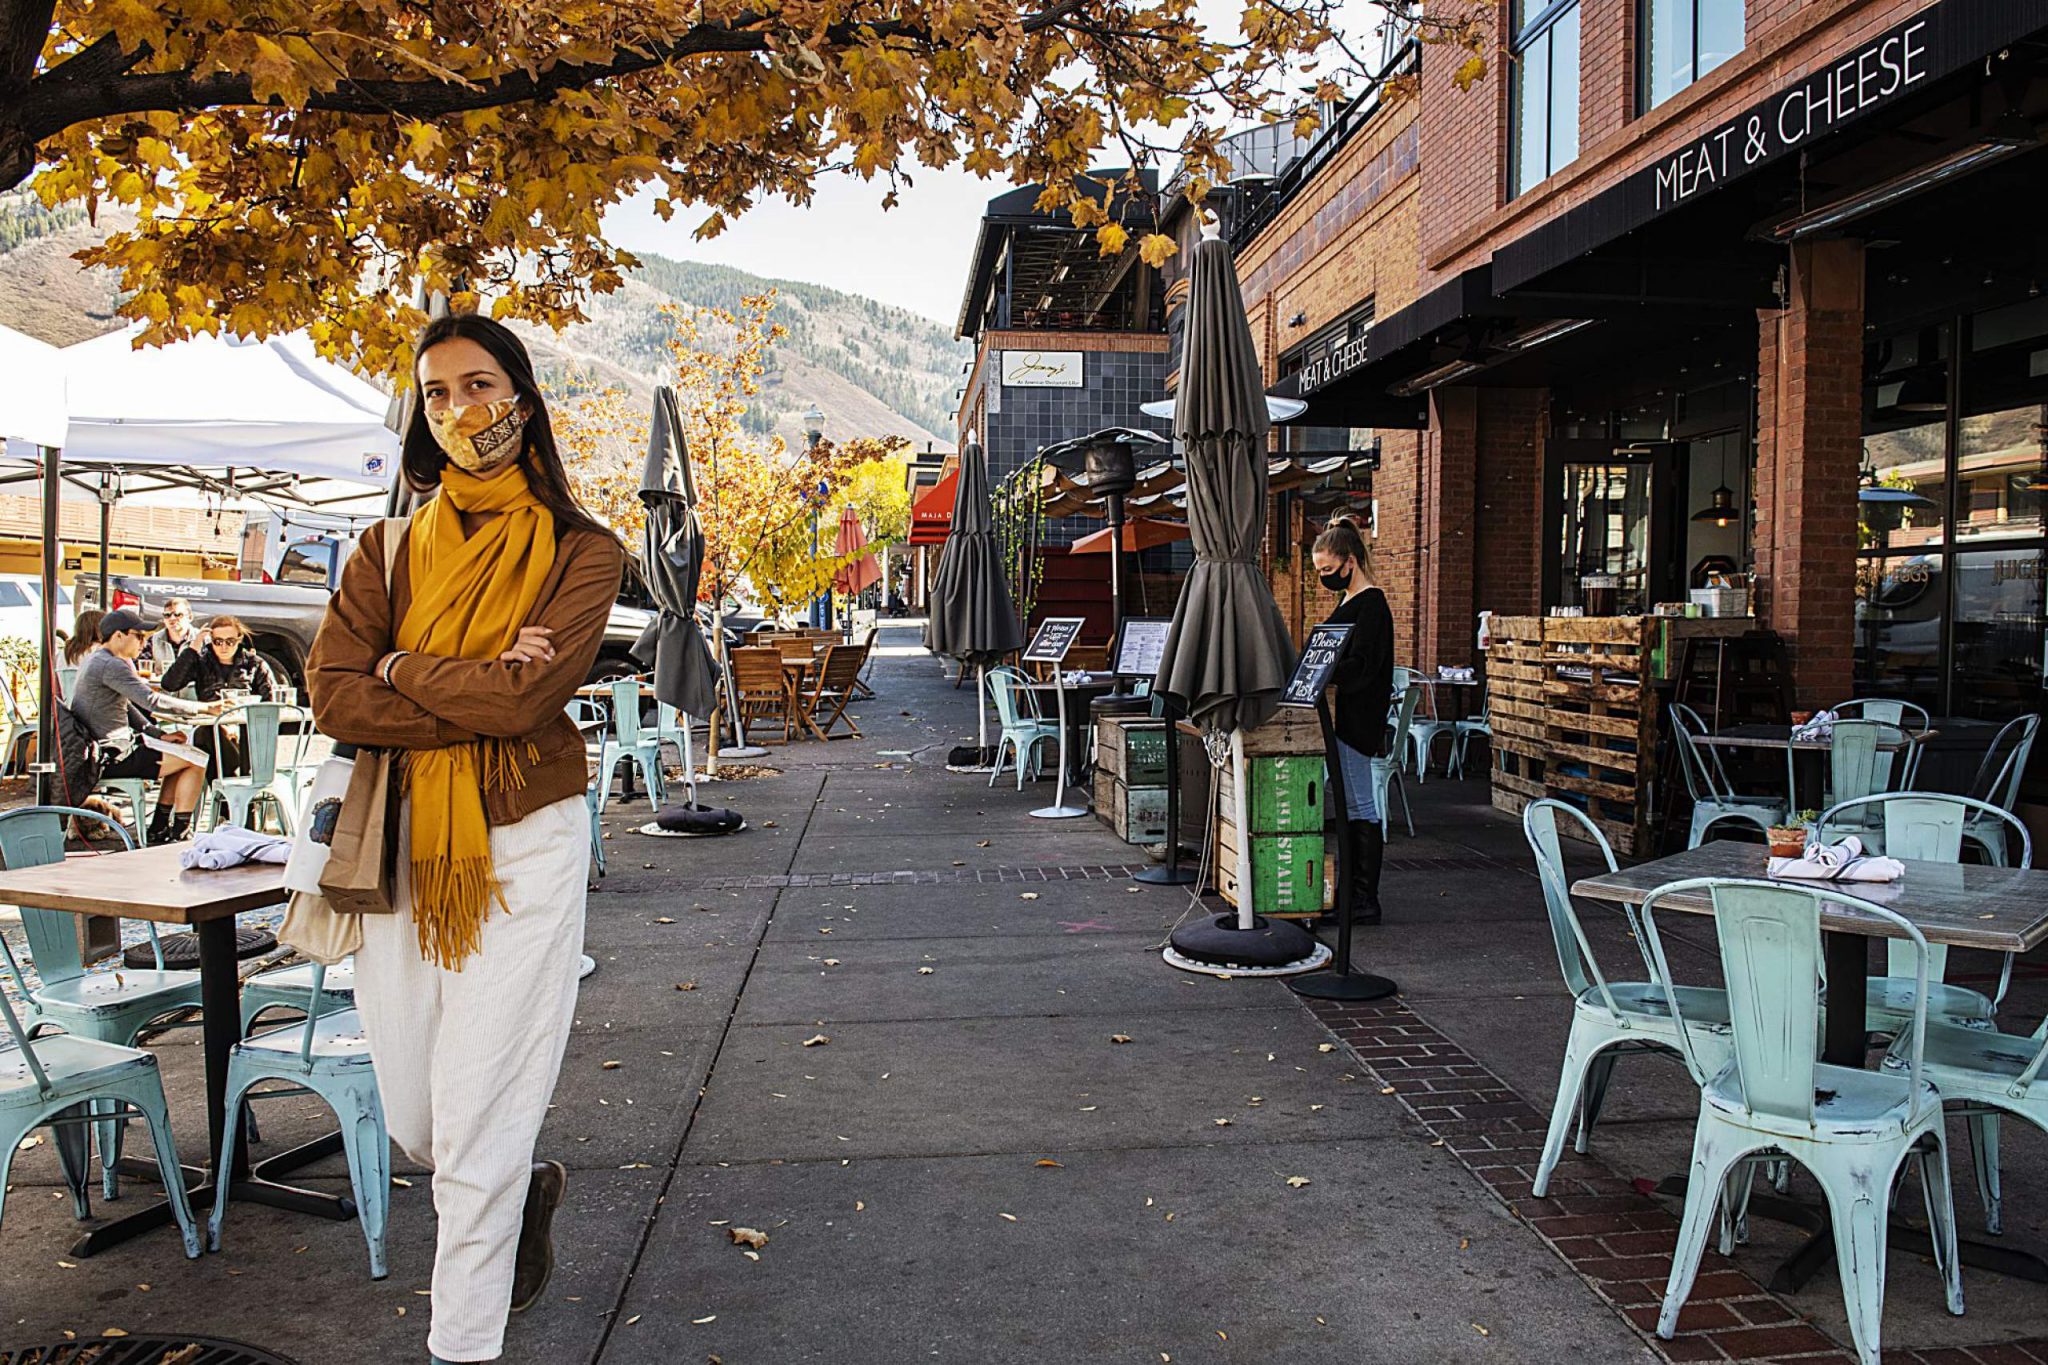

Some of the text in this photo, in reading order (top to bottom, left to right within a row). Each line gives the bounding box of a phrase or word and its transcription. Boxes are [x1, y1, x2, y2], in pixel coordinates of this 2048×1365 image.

[1655, 20, 1926, 211] MEAT & CHEESE
[1298, 334, 1368, 395] MEAT & CHEESE
[1312, 632, 1337, 647] Please
[1302, 649, 1335, 664] PUT ON
[1289, 680, 1315, 701] Mask
